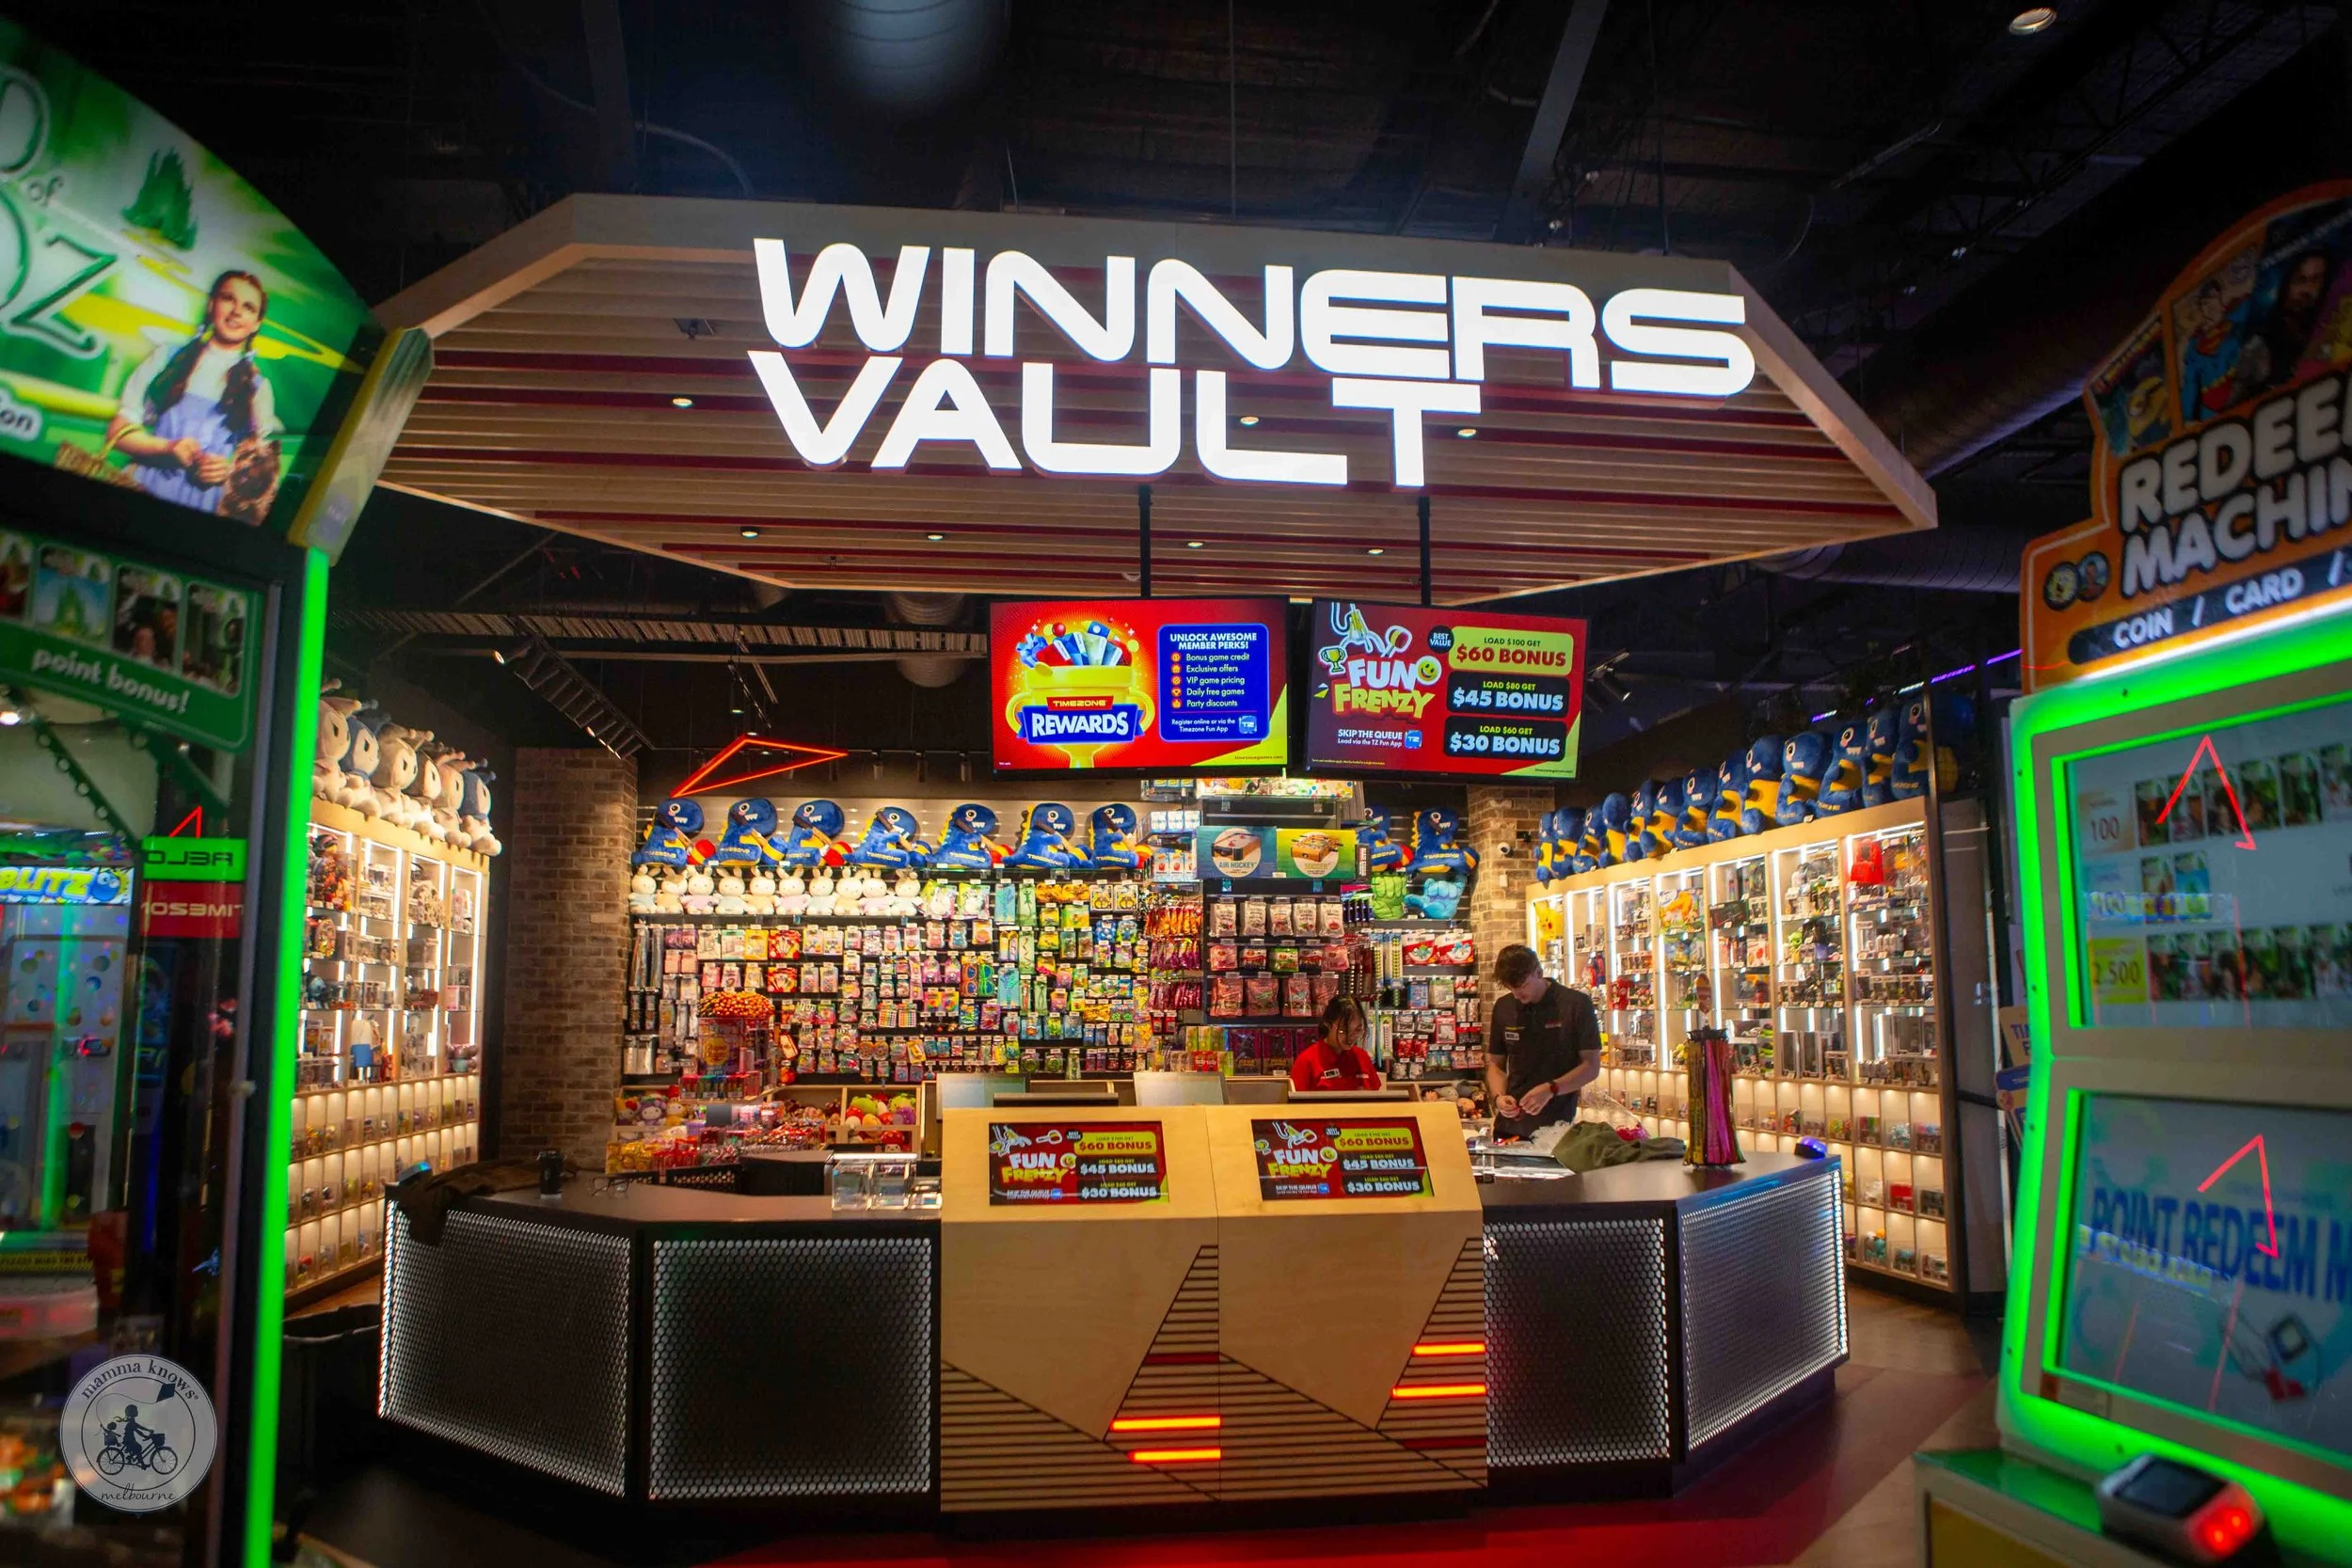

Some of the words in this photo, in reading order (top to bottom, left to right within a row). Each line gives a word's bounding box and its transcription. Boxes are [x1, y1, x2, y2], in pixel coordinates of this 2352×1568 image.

[753, 238, 1756, 396] WINNERS
[748, 350, 1481, 486] VAULT
[2120, 376, 2352, 533] REDEE
[2113, 608, 2173, 649] COIN
[2224, 567, 2304, 615] CARD
[1169, 633, 1209, 641] UNLOCK
[1210, 632, 1257, 641] AWESOME
[1429, 639, 1452, 647] VALUE
[1178, 641, 1216, 650] MEMBER
[1218, 641, 1248, 649] PERKS!
[1186, 653, 1208, 661] Bonus
[1209, 654, 1230, 663] game
[1231, 652, 1249, 660] credit
[1456, 643, 1495, 662] $60
[1499, 648, 1566, 667] BONUS
[1186, 664, 1217, 673] Exclusive
[1218, 663, 1238, 673] offers
[1347, 658, 1417, 691] FUN
[31, 649, 103, 684] point
[106, 662, 192, 715] bonus!
[1186, 676, 1199, 685] VIP
[1221, 676, 1245, 686] pricing
[1505, 682, 1520, 690] $80
[1186, 688, 1205, 697] Daily
[1206, 687, 1220, 695] free
[1221, 689, 1245, 697] games
[1453, 687, 1492, 707] $45
[1496, 691, 1564, 710] BONUS
[1053, 699, 1106, 707] TIMEZONE
[1186, 699, 1204, 708] Party
[1206, 699, 1238, 707] discounts
[1334, 683, 1436, 719] FRENZY
[1032, 711, 1129, 737] REWARDS
[1479, 725, 1501, 734] LOAD
[1502, 726, 1517, 735] $60
[1338, 729, 1358, 737] SKIP
[1358, 730, 1374, 738] THE
[1375, 730, 1403, 740] QUEUE
[1390, 740, 1403, 749] App
[1450, 732, 1488, 752] $30
[1492, 736, 1560, 754] BONUS
[2090, 816, 2121, 841] 100
[0, 866, 95, 898] BLITZ
[1079, 1141, 1104, 1151] $60
[1107, 1141, 1152, 1149] BONUS
[1339, 1138, 1363, 1148] $60
[1366, 1137, 1409, 1146] BONUS
[1009, 1151, 1056, 1169] FUN
[1273, 1148, 1318, 1164] FUN
[1080, 1163, 1106, 1175] $45
[1109, 1164, 1155, 1174] BONUS
[1267, 1163, 1332, 1179] FRENZY
[1343, 1159, 1368, 1170] $45
[1371, 1159, 1414, 1168] BONUS
[1001, 1166, 1069, 1183] FRENZY
[1082, 1187, 1108, 1198] $30
[1110, 1187, 1157, 1197] BONUS
[1347, 1181, 1373, 1194] $30
[1375, 1180, 1420, 1192] BONUS
[2090, 1186, 2180, 1267] POINT
[2182, 1198, 2316, 1298] REDEEM
